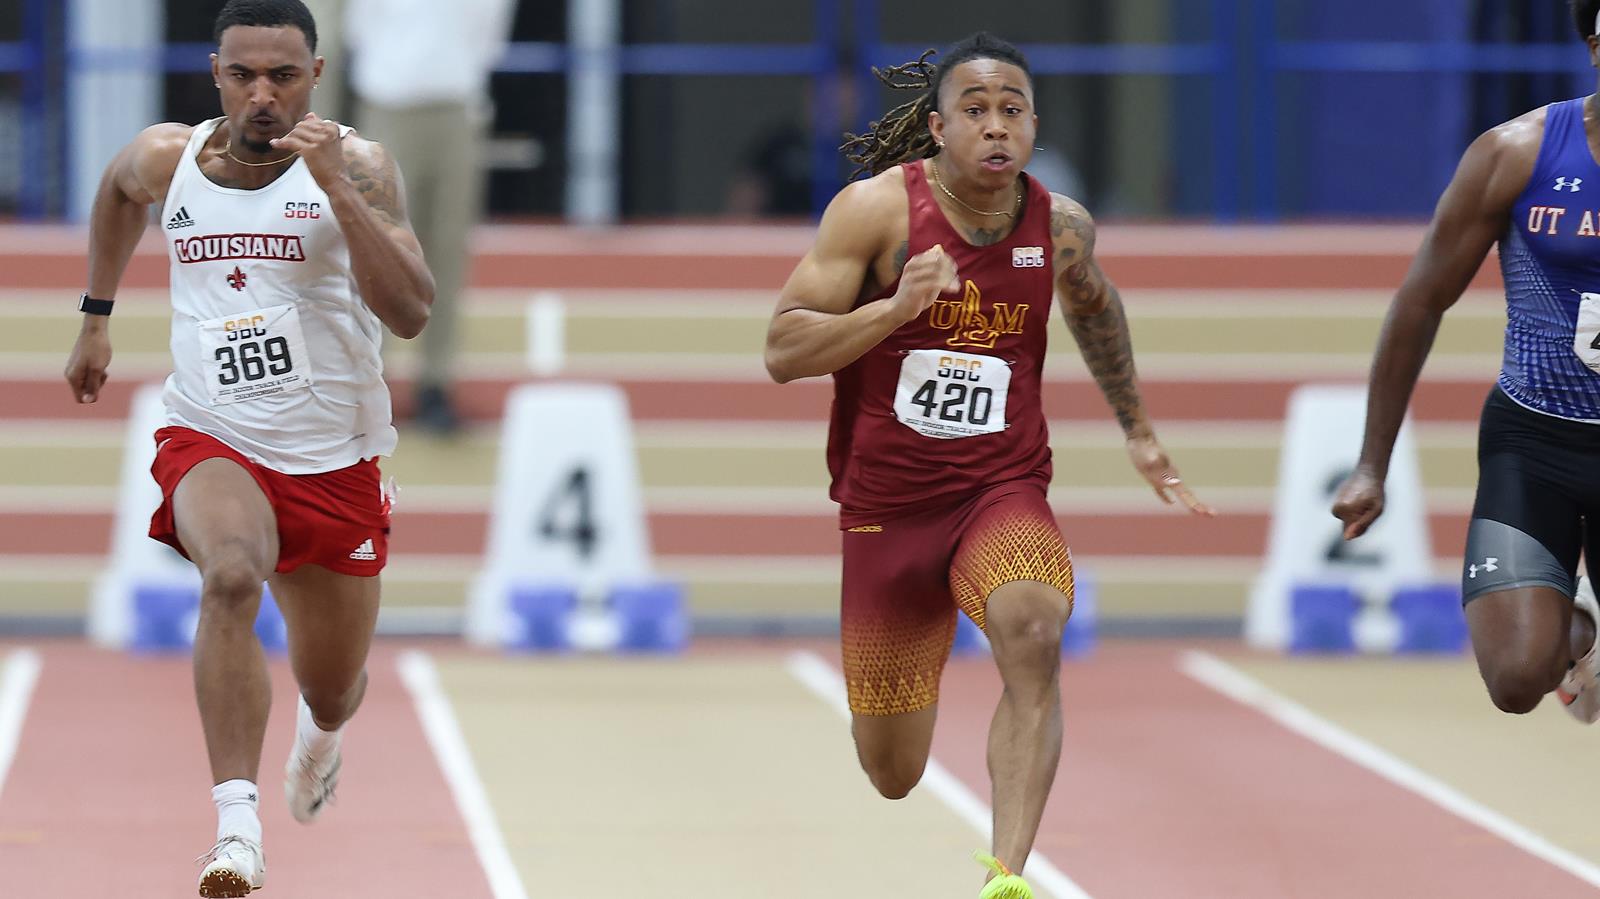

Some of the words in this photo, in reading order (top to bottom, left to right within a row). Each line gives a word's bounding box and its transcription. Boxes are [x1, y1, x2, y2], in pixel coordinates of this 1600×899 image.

[167, 219, 195, 230] adidas
[284, 201, 320, 219] SBC
[1527, 206, 1565, 235] UT
[175, 233, 305, 263] LOUISIANA
[224, 315, 266, 341] SBC
[215, 335, 293, 386] 369
[938, 356, 982, 382] SBC
[911, 379, 993, 426] 420
[535, 466, 602, 565] 4
